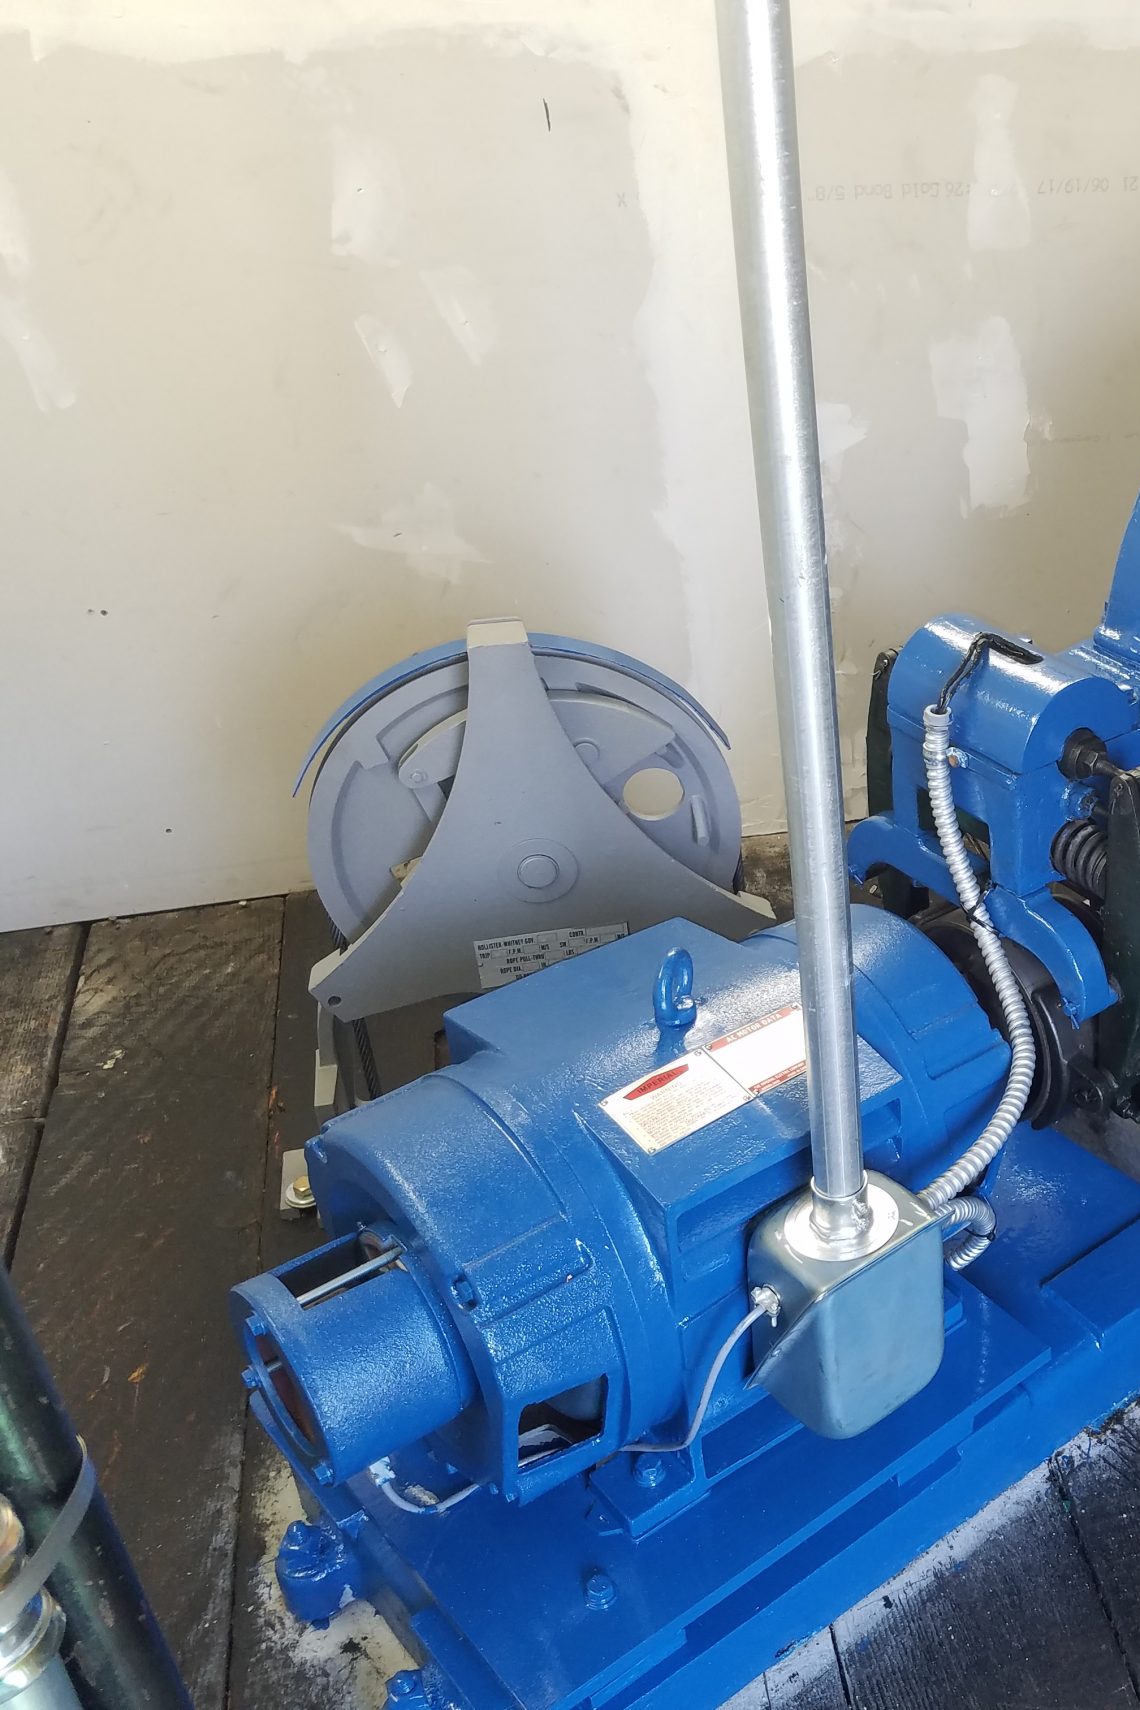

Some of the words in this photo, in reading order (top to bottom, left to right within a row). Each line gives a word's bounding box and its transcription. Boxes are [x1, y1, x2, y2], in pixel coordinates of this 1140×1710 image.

[854, 183, 893, 200] Bond
[725, 1032, 738, 1043] AC
[736, 1022, 762, 1038] MOTOR
[761, 1013, 782, 1025] DATA
[637, 1071, 679, 1094] IMPERIAL
